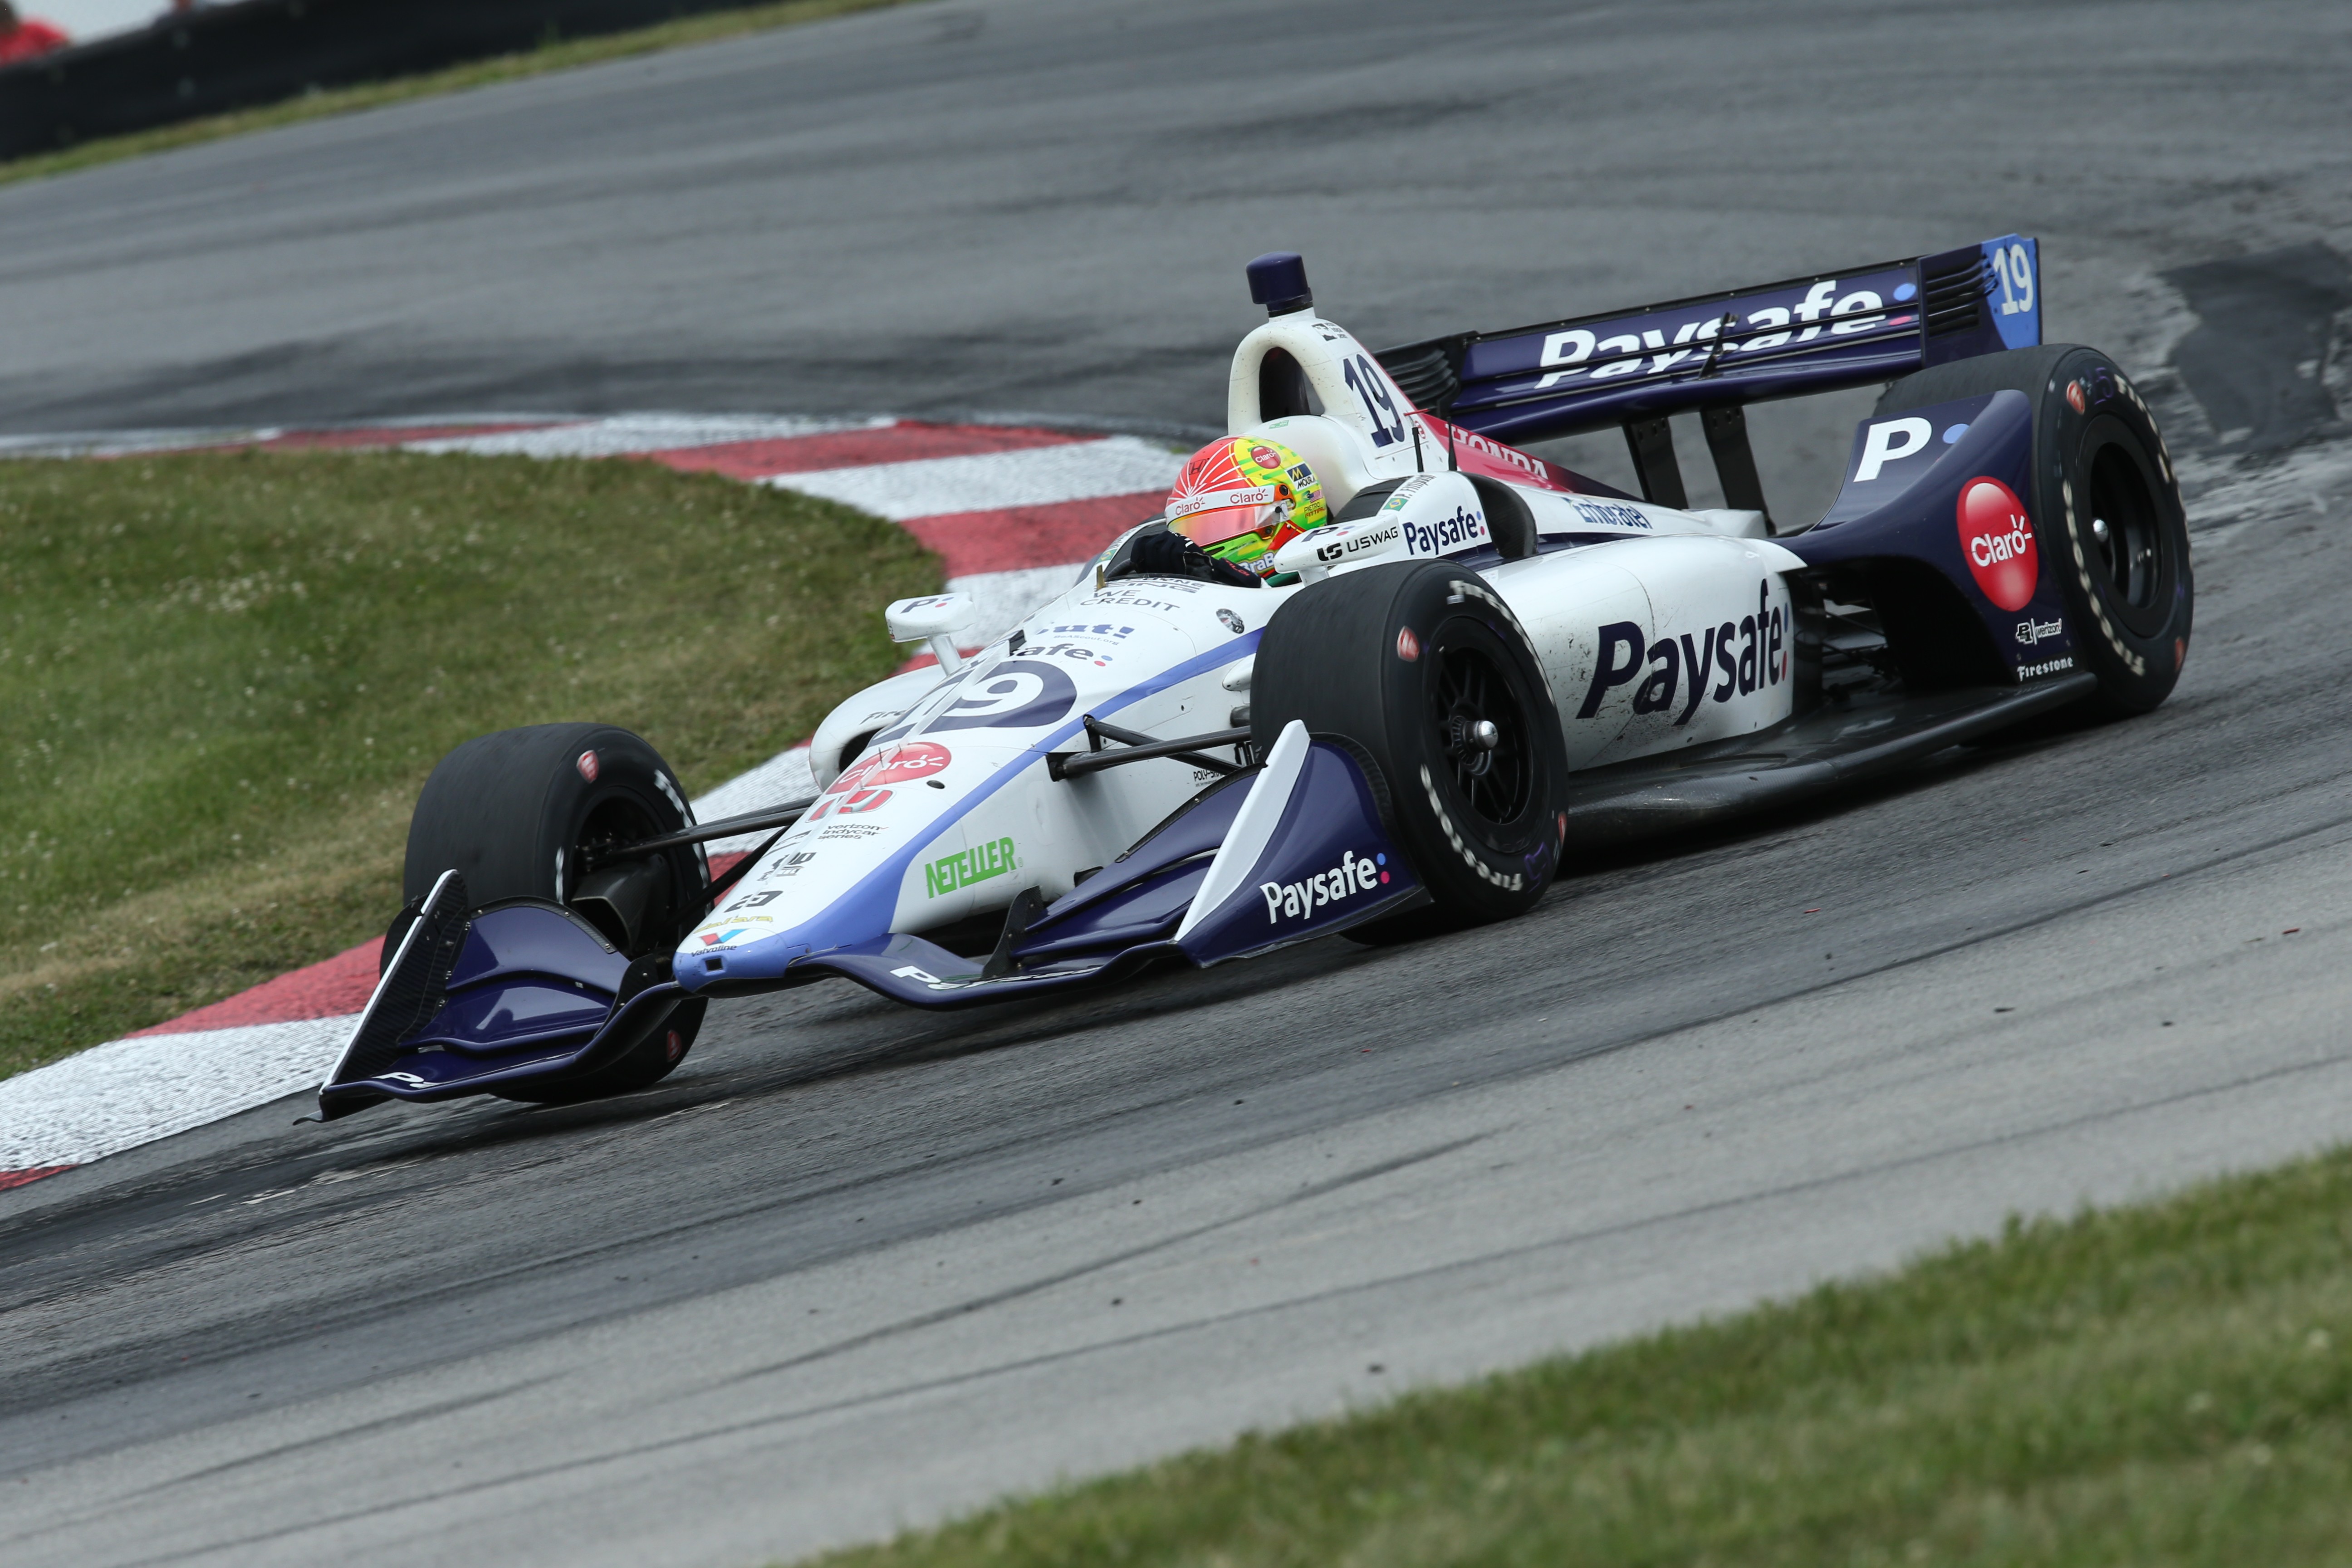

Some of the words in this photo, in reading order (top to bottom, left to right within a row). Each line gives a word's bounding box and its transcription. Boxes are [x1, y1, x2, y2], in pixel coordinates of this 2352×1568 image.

[1993, 243, 2034, 316] 19
[1343, 354, 1405, 448] 19
[1254, 450, 1275, 463] Claro
[1175, 501, 1200, 515] Claro
[1230, 492, 1264, 504] Claro
[1347, 526, 1399, 553] USWAG
[1971, 530, 2026, 567] Claro
[1080, 598, 1181, 611] CREDIT
[1093, 590, 1141, 598] WE
[2017, 657, 2073, 682] Firestone
[925, 837, 1017, 899] NETELLER
